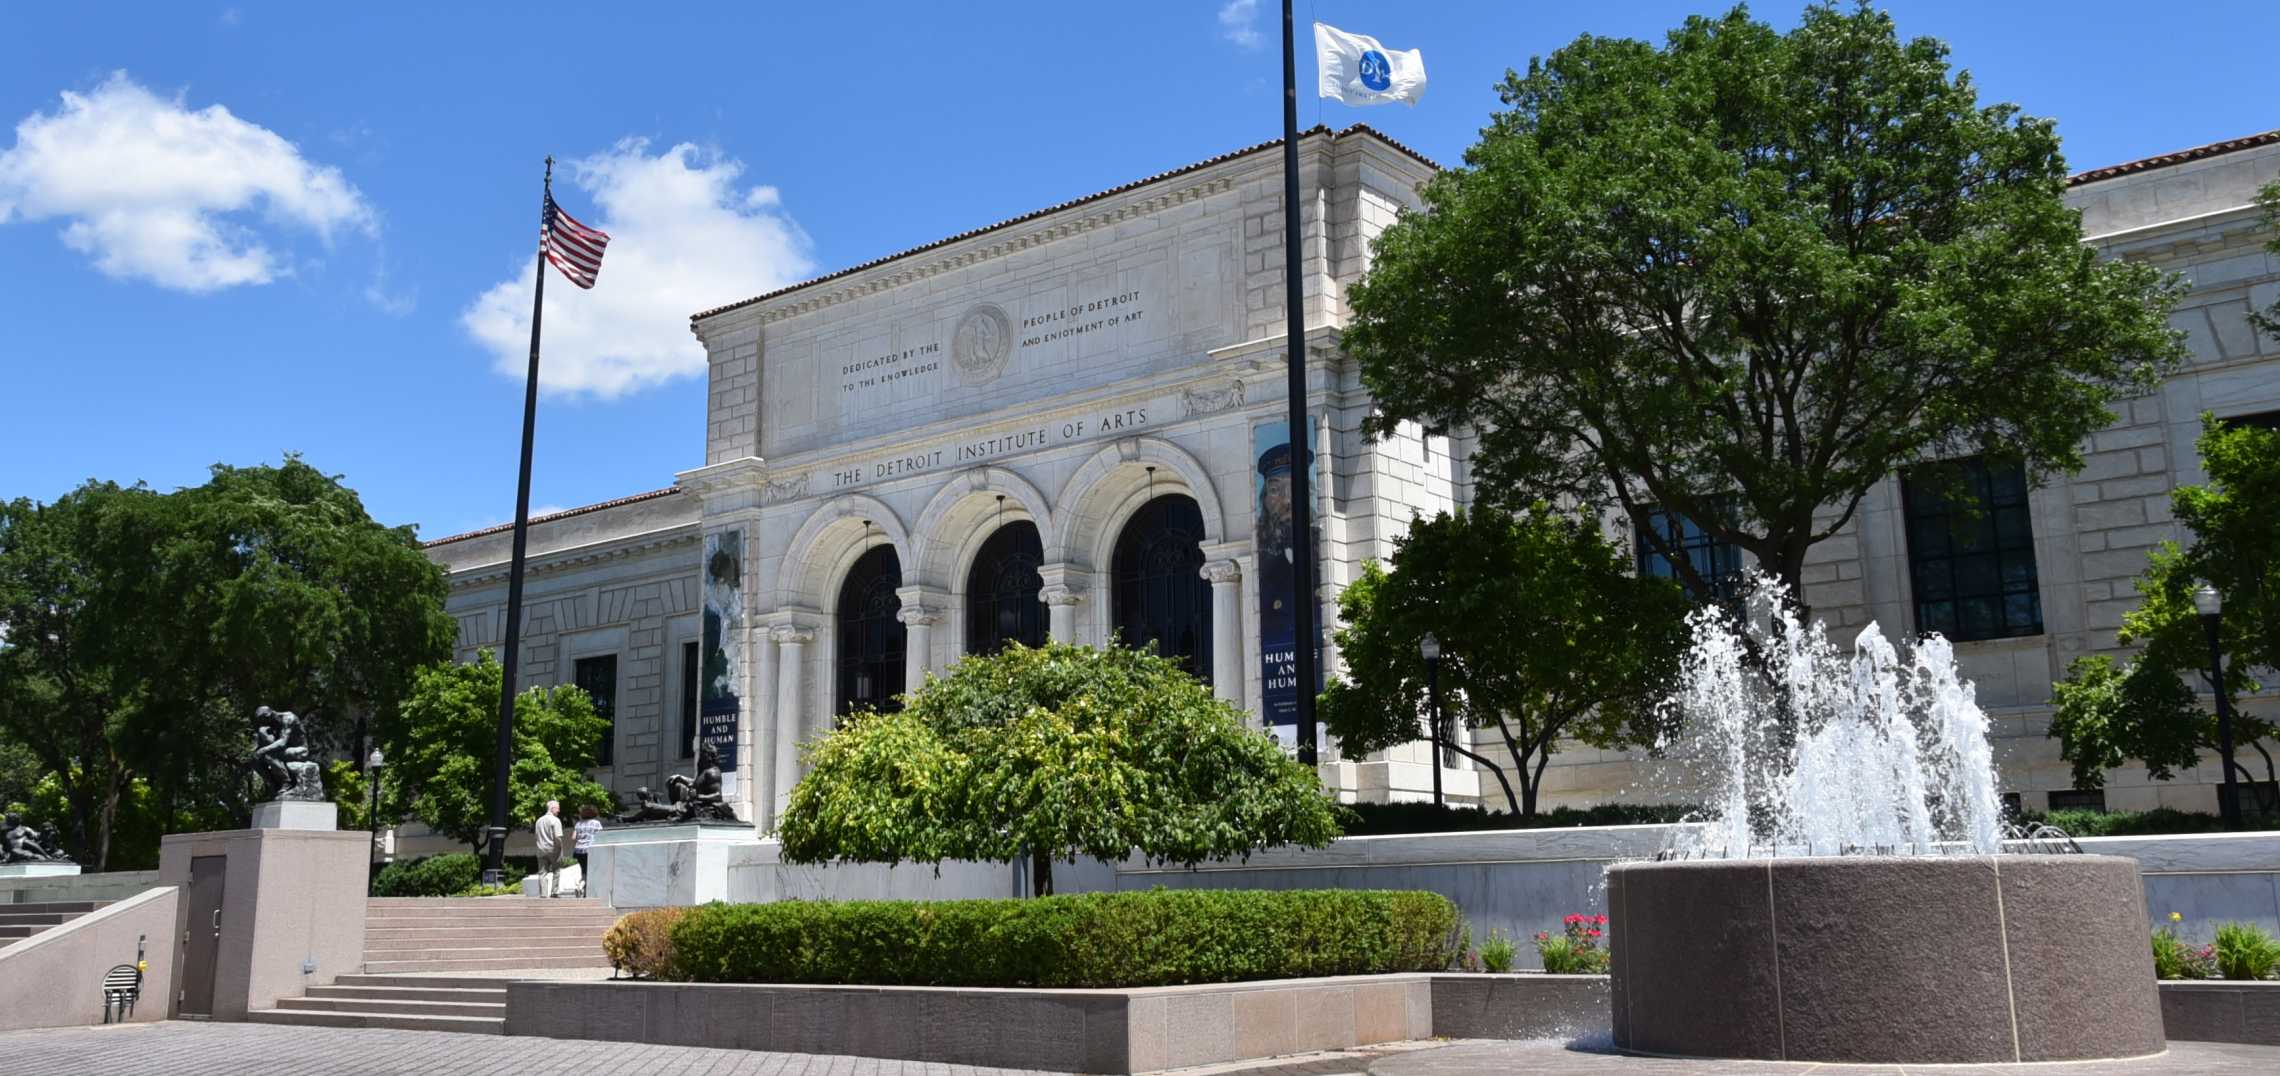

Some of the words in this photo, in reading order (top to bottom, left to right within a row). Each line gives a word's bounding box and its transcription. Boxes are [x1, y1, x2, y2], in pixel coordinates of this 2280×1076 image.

[843, 354, 898, 375] DEDICATED
[903, 349, 914, 359] BY
[920, 343, 939, 355] THE
[1024, 310, 1065, 328] PEOPLE
[1071, 305, 1084, 316] OF
[1088, 292, 1139, 312] DETROIT
[843, 384, 854, 392] TO
[860, 378, 875, 388] THE
[881, 362, 938, 383] KNOWLEDGE
[1023, 337, 1040, 347] AND
[1108, 316, 1120, 326] OF
[1125, 311, 1143, 322] ART
[835, 469, 861, 486] THE
[876, 451, 942, 478] DETROIT
[958, 429, 1046, 461] INSTITUTE
[1063, 421, 1084, 438] OF
[1101, 408, 1146, 431] ARTS
[1278, 664, 1296, 675] AN
[1268, 677, 1297, 689] HUM
[704, 714, 736, 724] HUMBLE
[712, 725, 728, 734] AND
[704, 735, 734, 744] HUMAN
